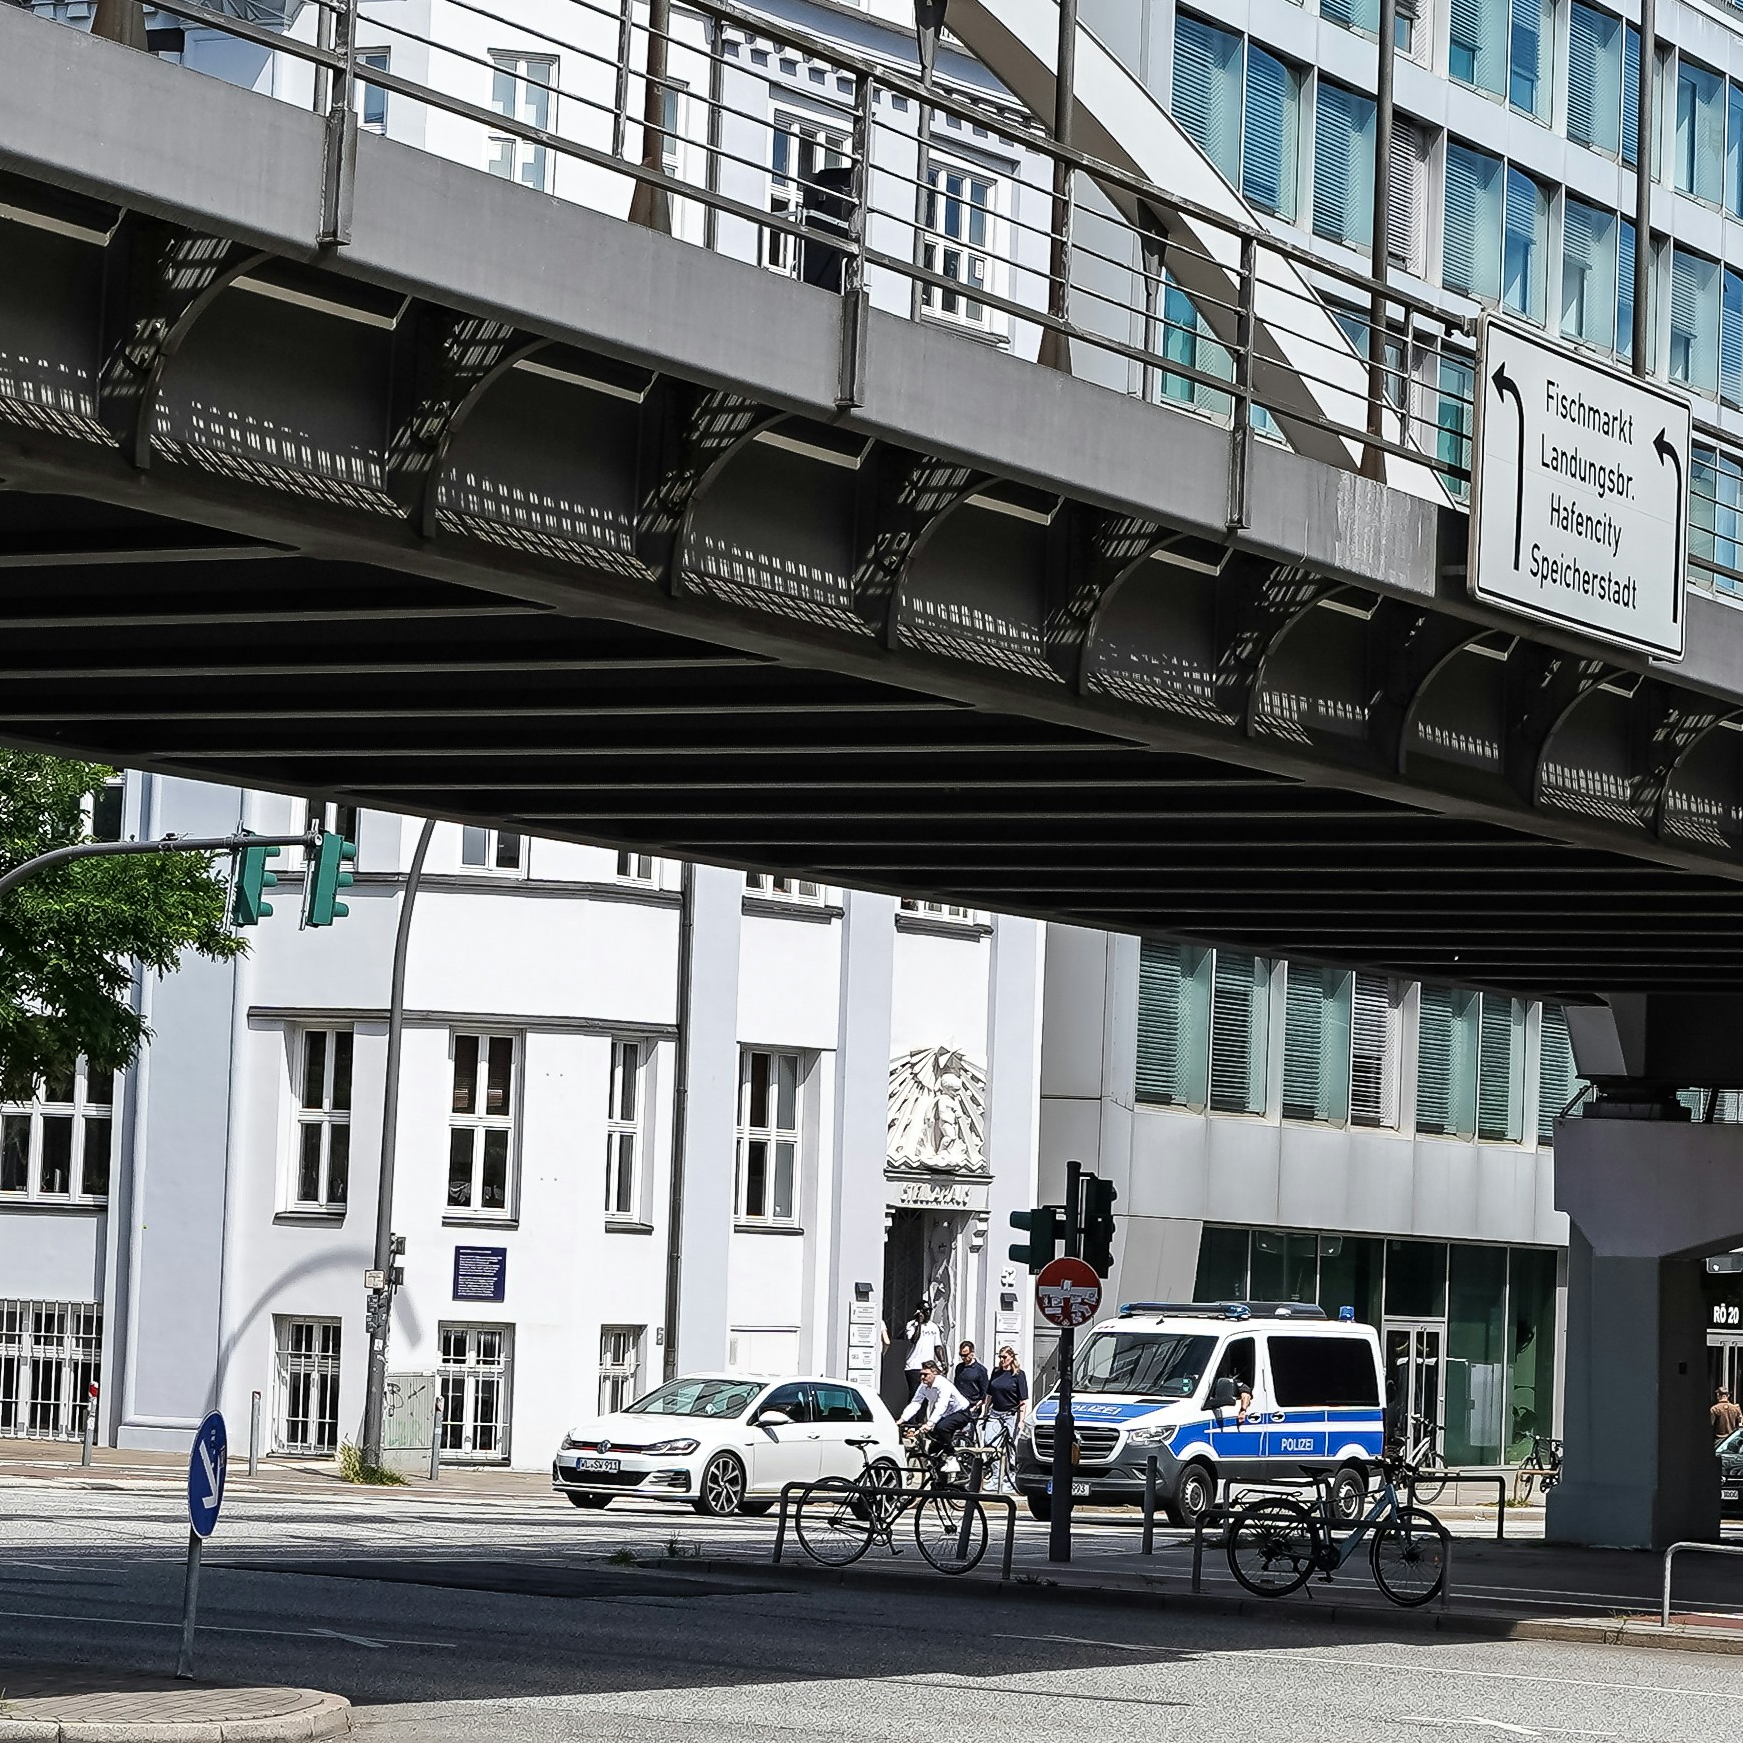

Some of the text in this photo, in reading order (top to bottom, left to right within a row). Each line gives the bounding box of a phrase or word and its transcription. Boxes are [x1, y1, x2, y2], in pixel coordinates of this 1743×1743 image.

[1546, 379, 1633, 445] Fischmarkt
[1541, 433, 1635, 501] Landungsbr.
[1550, 492, 1622, 557] Hafencity
[1530, 543, 1636, 610] Speicherstadt
[1000, 1267, 1017, 1288] 52
[1728, 1307, 1739, 1324] 20
[1281, 1438, 1314, 1451] POLIZEI
